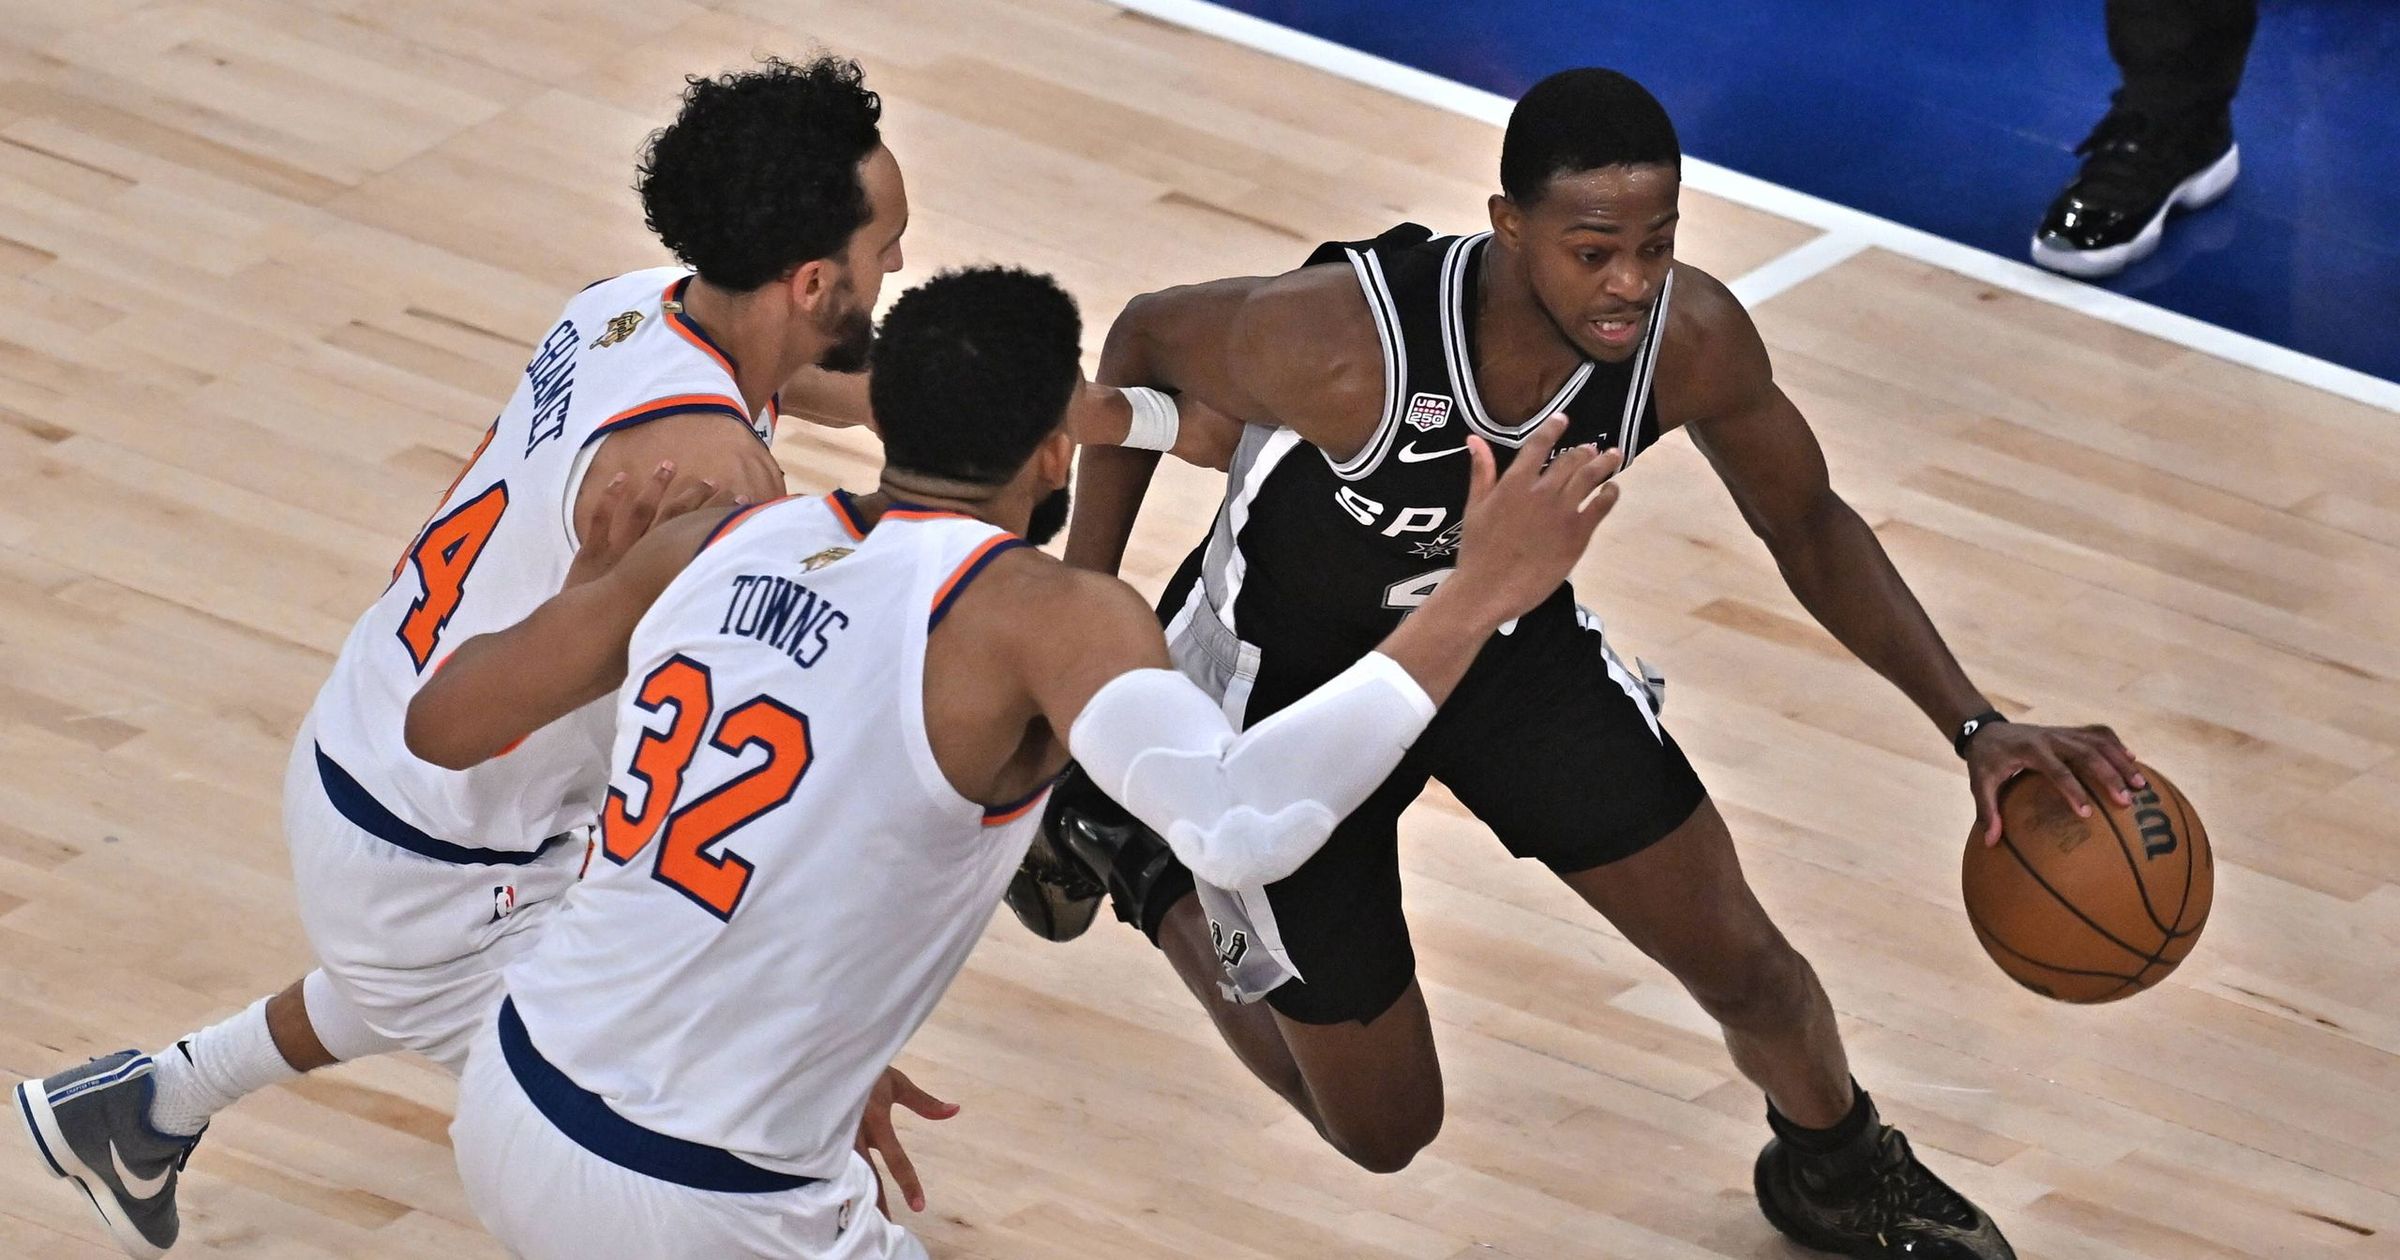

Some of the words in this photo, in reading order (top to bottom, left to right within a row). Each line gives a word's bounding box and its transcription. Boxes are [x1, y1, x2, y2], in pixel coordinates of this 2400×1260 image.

[525, 320, 580, 460] SHAMET
[1409, 412, 1445, 425] 250
[1416, 398, 1446, 410] USA
[381, 415, 509, 677] 4
[720, 575, 849, 669] TOWNS
[602, 653, 814, 923] 32
